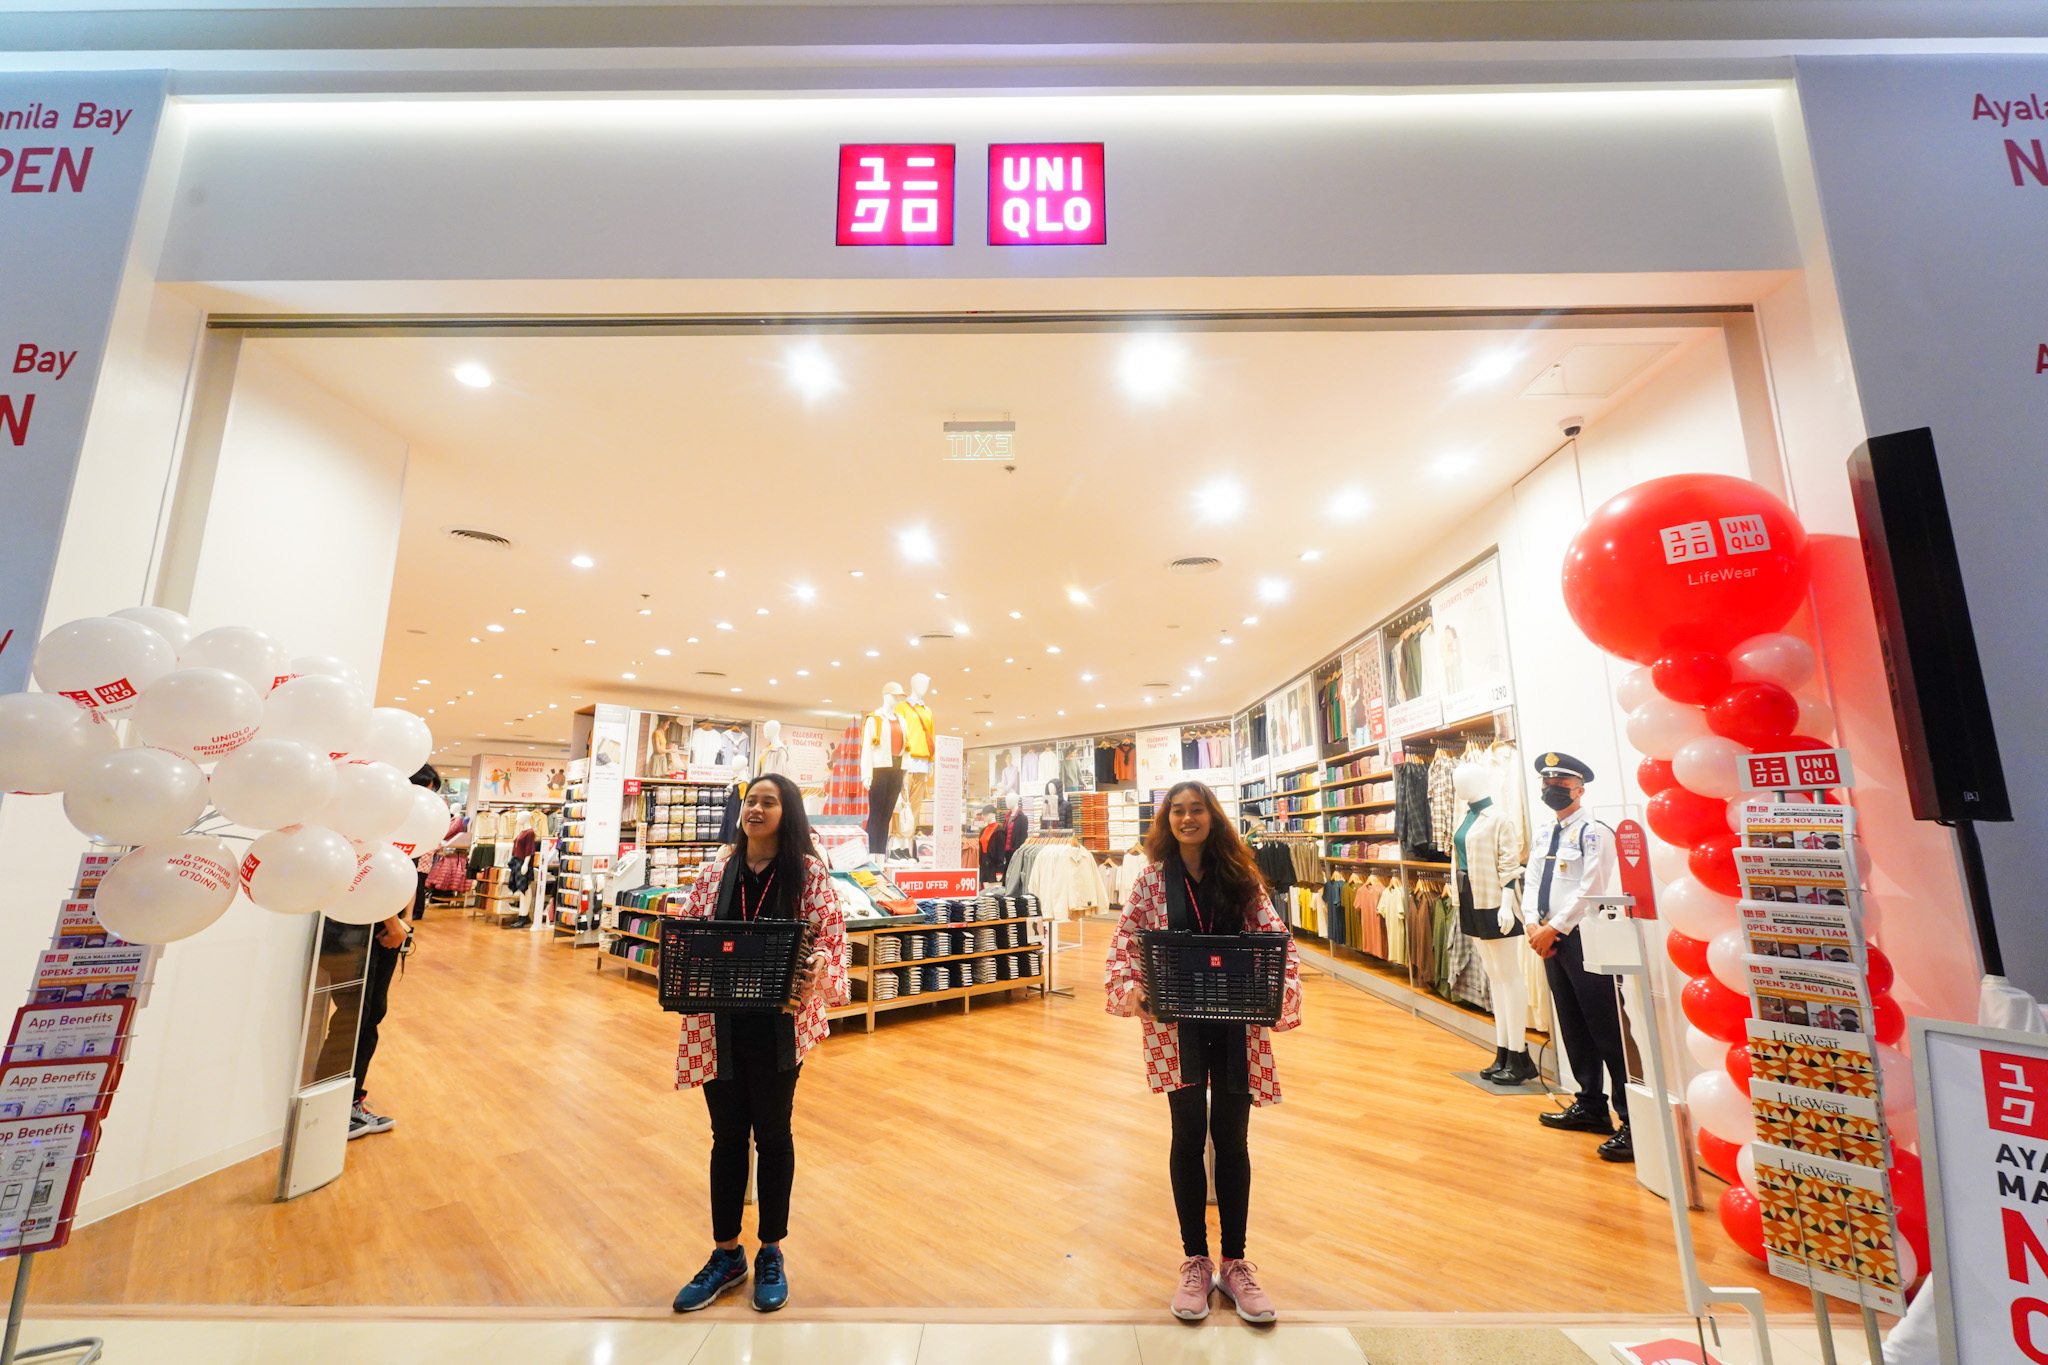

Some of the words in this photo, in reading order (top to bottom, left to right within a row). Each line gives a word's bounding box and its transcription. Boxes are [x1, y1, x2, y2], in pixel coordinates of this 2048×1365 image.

[73, 102, 133, 135] Bay
[855, 157, 938, 190] ユニ
[1003, 157, 1082, 191] UNI
[850, 198, 938, 232] クロ
[1003, 197, 1091, 238] QLO
[12, 343, 77, 380] Bay
[1670, 527, 1706, 543] ユニ
[1727, 520, 1759, 534] UNI
[1673, 541, 1709, 558] クロ
[1731, 534, 1765, 550] QLO
[1688, 567, 1759, 586] LifeWear
[99, 682, 125, 696] UNI
[105, 689, 132, 702] QLO
[211, 726, 250, 743] UNIQLO
[792, 731, 824, 740] CELEBRATE
[193, 740, 236, 751] GROUND
[792, 739, 823, 748] TOGETHER
[1754, 761, 1783, 772] ユニ
[1799, 758, 1830, 770] UNI
[1756, 772, 1785, 784] クロ
[1803, 770, 1835, 783] QLO
[168, 859, 202, 870] FLOOR
[179, 870, 218, 891] UNIQLO
[1818, 871, 1845, 879] 11AM
[926, 880, 948, 890] OFFER
[1747, 924, 1778, 932] OPENS
[1781, 926, 1793, 934] 25
[1821, 929, 1848, 938] 11AM
[40, 968, 74, 977] OPENS
[1753, 979, 1786, 988] OPENS
[1789, 982, 1802, 990] 25
[1831, 988, 1858, 999] 11AM
[28, 1018, 56, 1029] App
[60, 1012, 113, 1026] Benefits
[1772, 1030, 1840, 1049] LifeWear
[10, 1076, 38, 1088] App
[41, 1071, 97, 1084] Benefits
[1999, 1063, 2034, 1093] ユ
[1777, 1092, 1848, 1115] LifeWear
[2001, 1096, 2035, 1127] ク
[18, 1124, 75, 1140] Benefits
[1779, 1158, 1852, 1186] LifeWear
